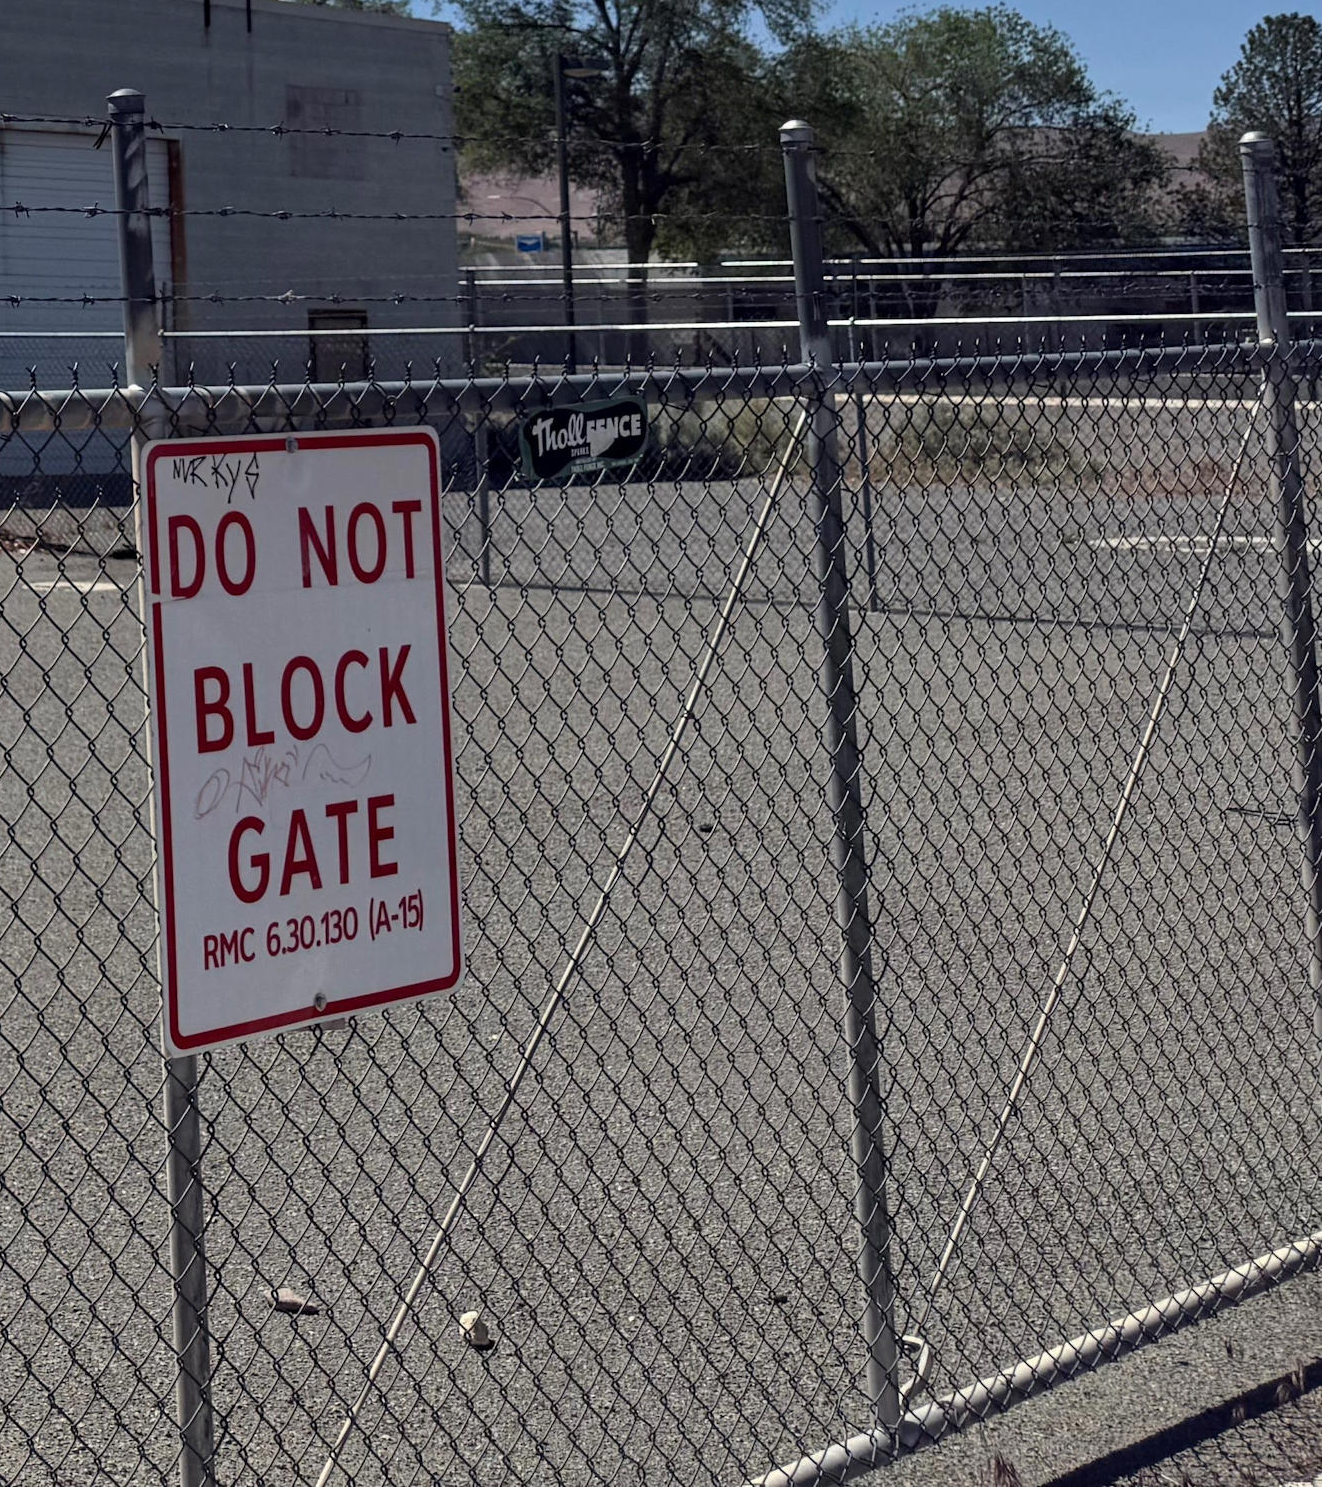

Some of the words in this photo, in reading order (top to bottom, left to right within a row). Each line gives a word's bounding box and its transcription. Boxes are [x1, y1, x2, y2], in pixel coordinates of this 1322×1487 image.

[531, 412, 587, 457] Tholl
[586, 413, 642, 443] FENCE
[168, 511, 256, 599] DO
[298, 500, 422, 589] NOT
[194, 644, 418, 754] BLOCK
[228, 794, 399, 904] GATE
[203, 926, 257, 972] RMC
[266, 906, 359, 958] 6.30.130
[369, 888, 425, 942] (A-15)
